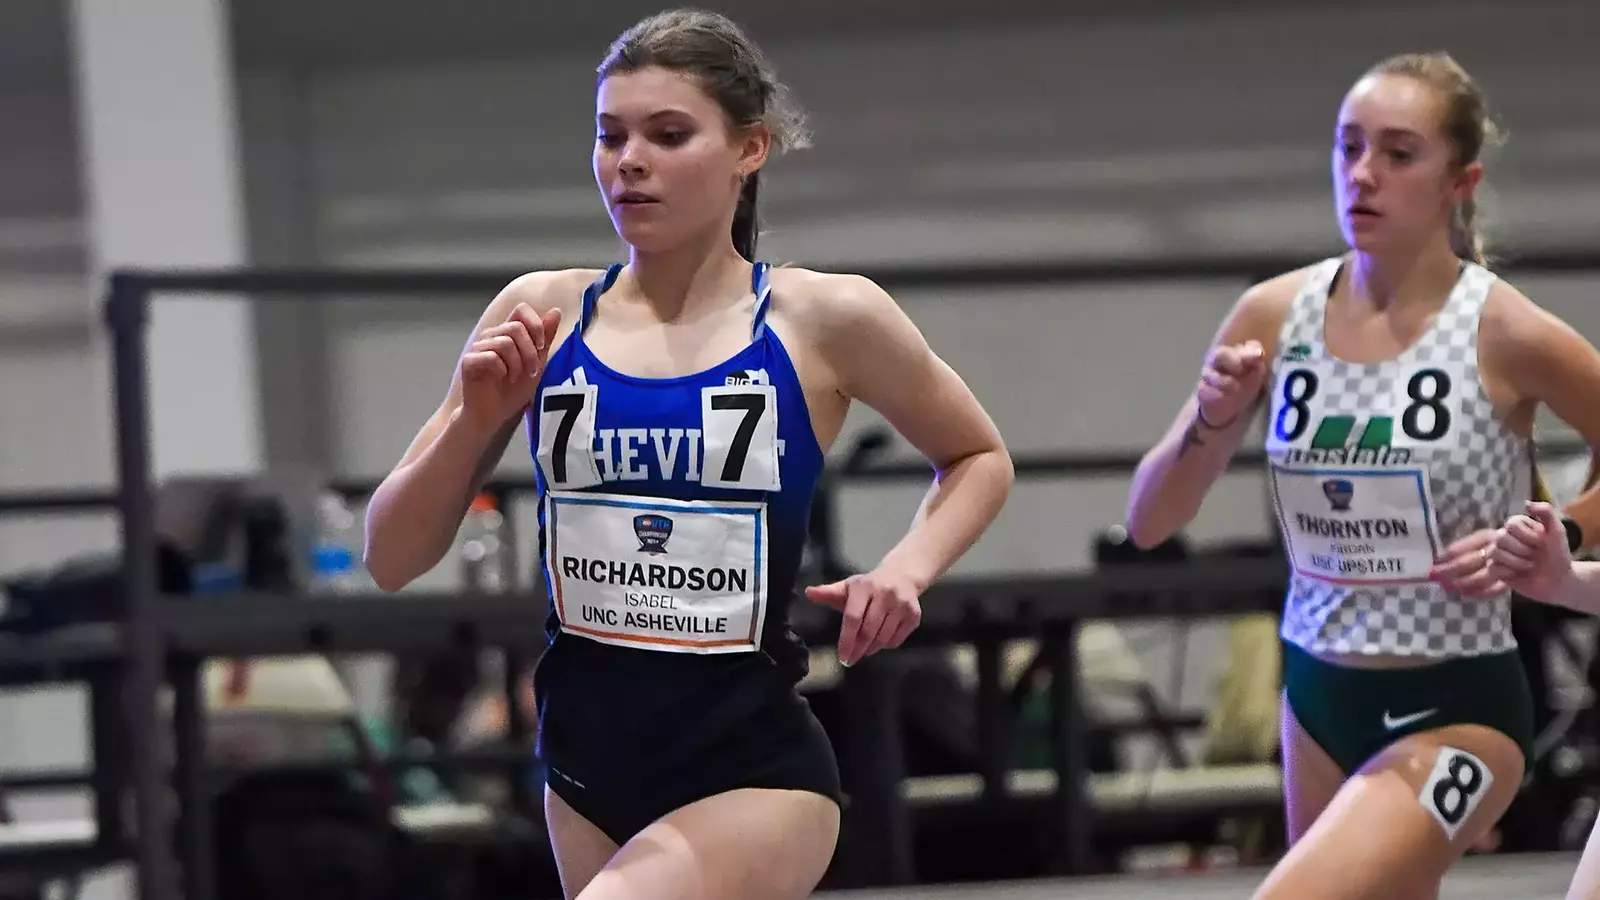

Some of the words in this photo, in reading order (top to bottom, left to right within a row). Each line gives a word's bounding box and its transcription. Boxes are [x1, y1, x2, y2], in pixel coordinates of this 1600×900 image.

[1275, 368, 1319, 442] 8
[1402, 368, 1452, 441] 8
[543, 393, 585, 483] 7
[711, 394, 766, 482] 7
[1296, 513, 1409, 539] THORNTON
[562, 556, 747, 592] RICHARDSON
[1338, 555, 1407, 574] UPSTATE
[582, 604, 618, 627] UNC
[624, 611, 728, 634] ASHEVILLE
[625, 592, 678, 610] ISABEL
[1433, 753, 1483, 825] 8
